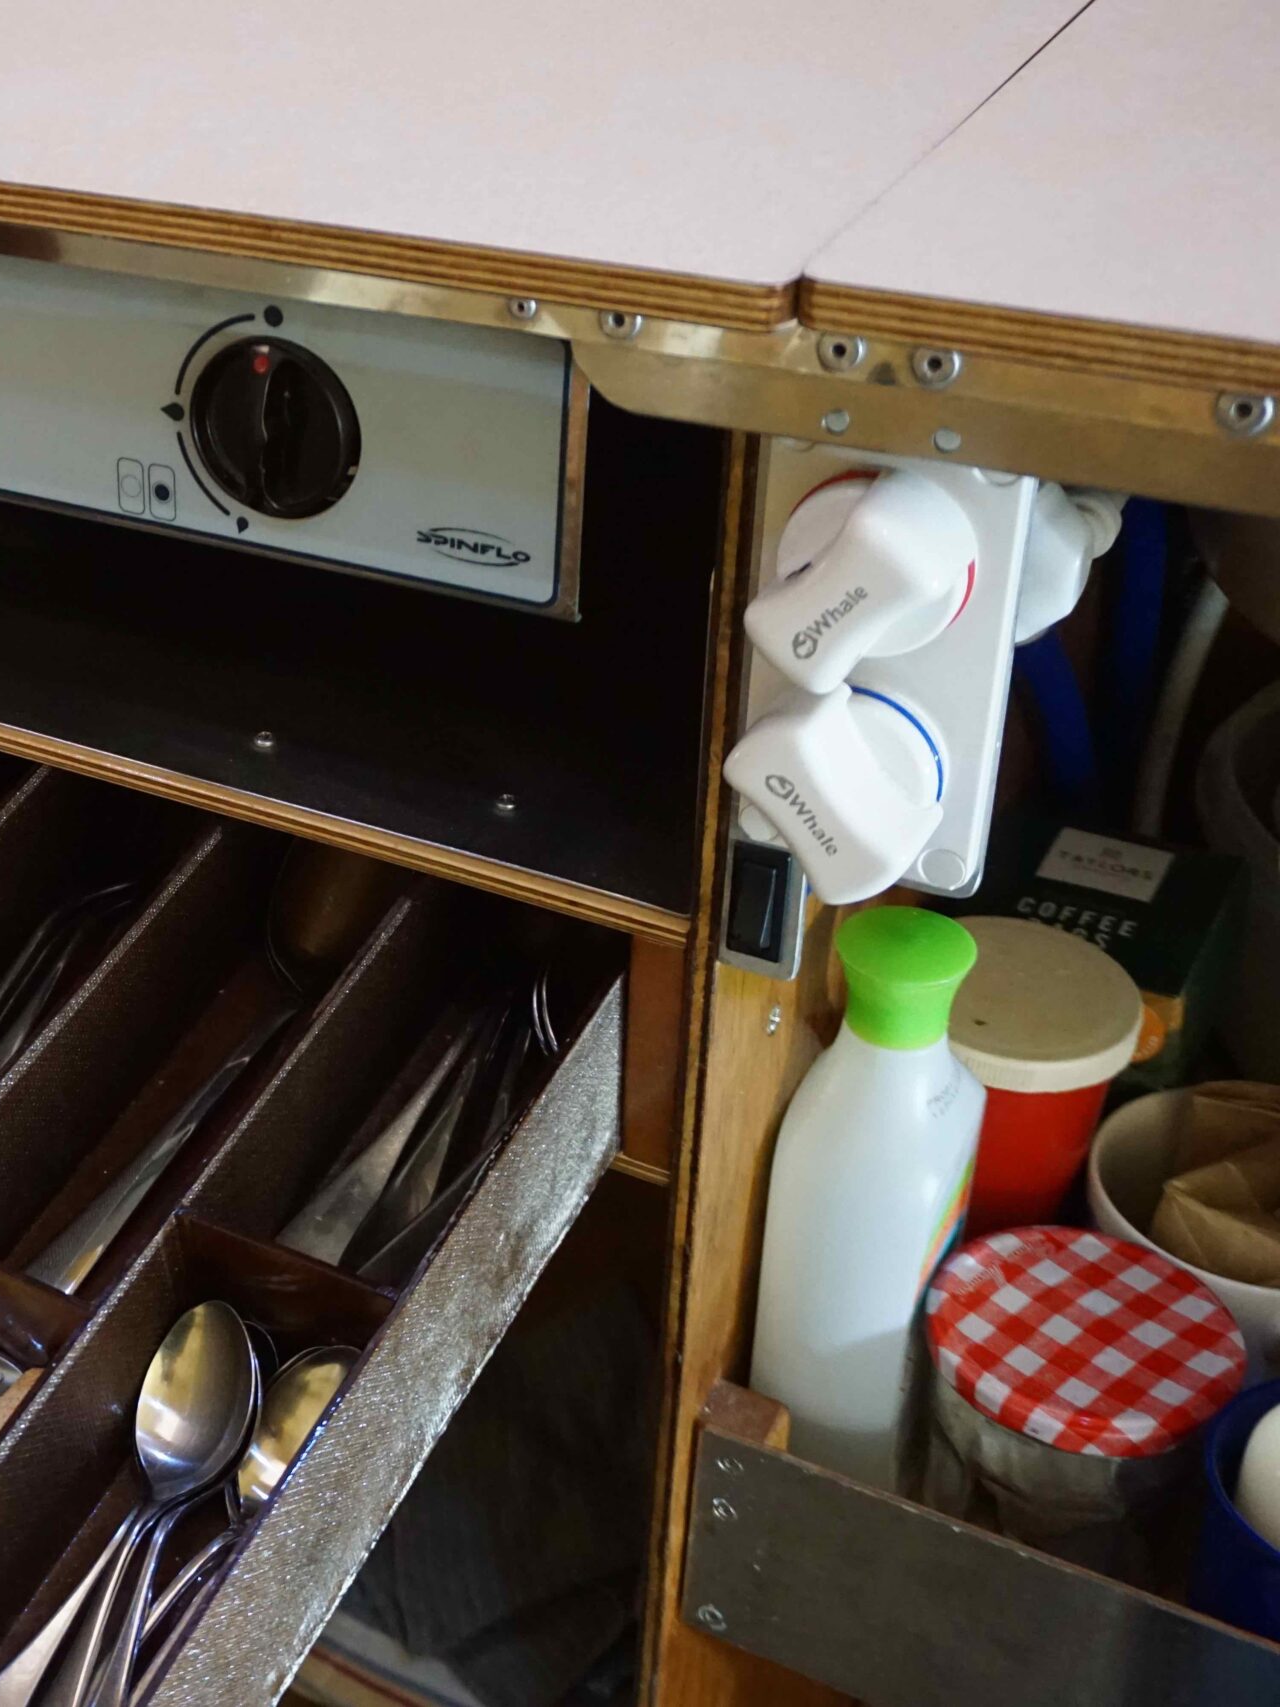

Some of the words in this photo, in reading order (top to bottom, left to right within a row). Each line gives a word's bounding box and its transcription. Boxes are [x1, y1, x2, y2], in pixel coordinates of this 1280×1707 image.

[417, 530, 531, 563] SPINFLO
[807, 585, 869, 639] Whale
[787, 791, 838, 857] Whale
[1059, 850, 1154, 881] TAYLORS
[1017, 897, 1138, 939] COFFEE
